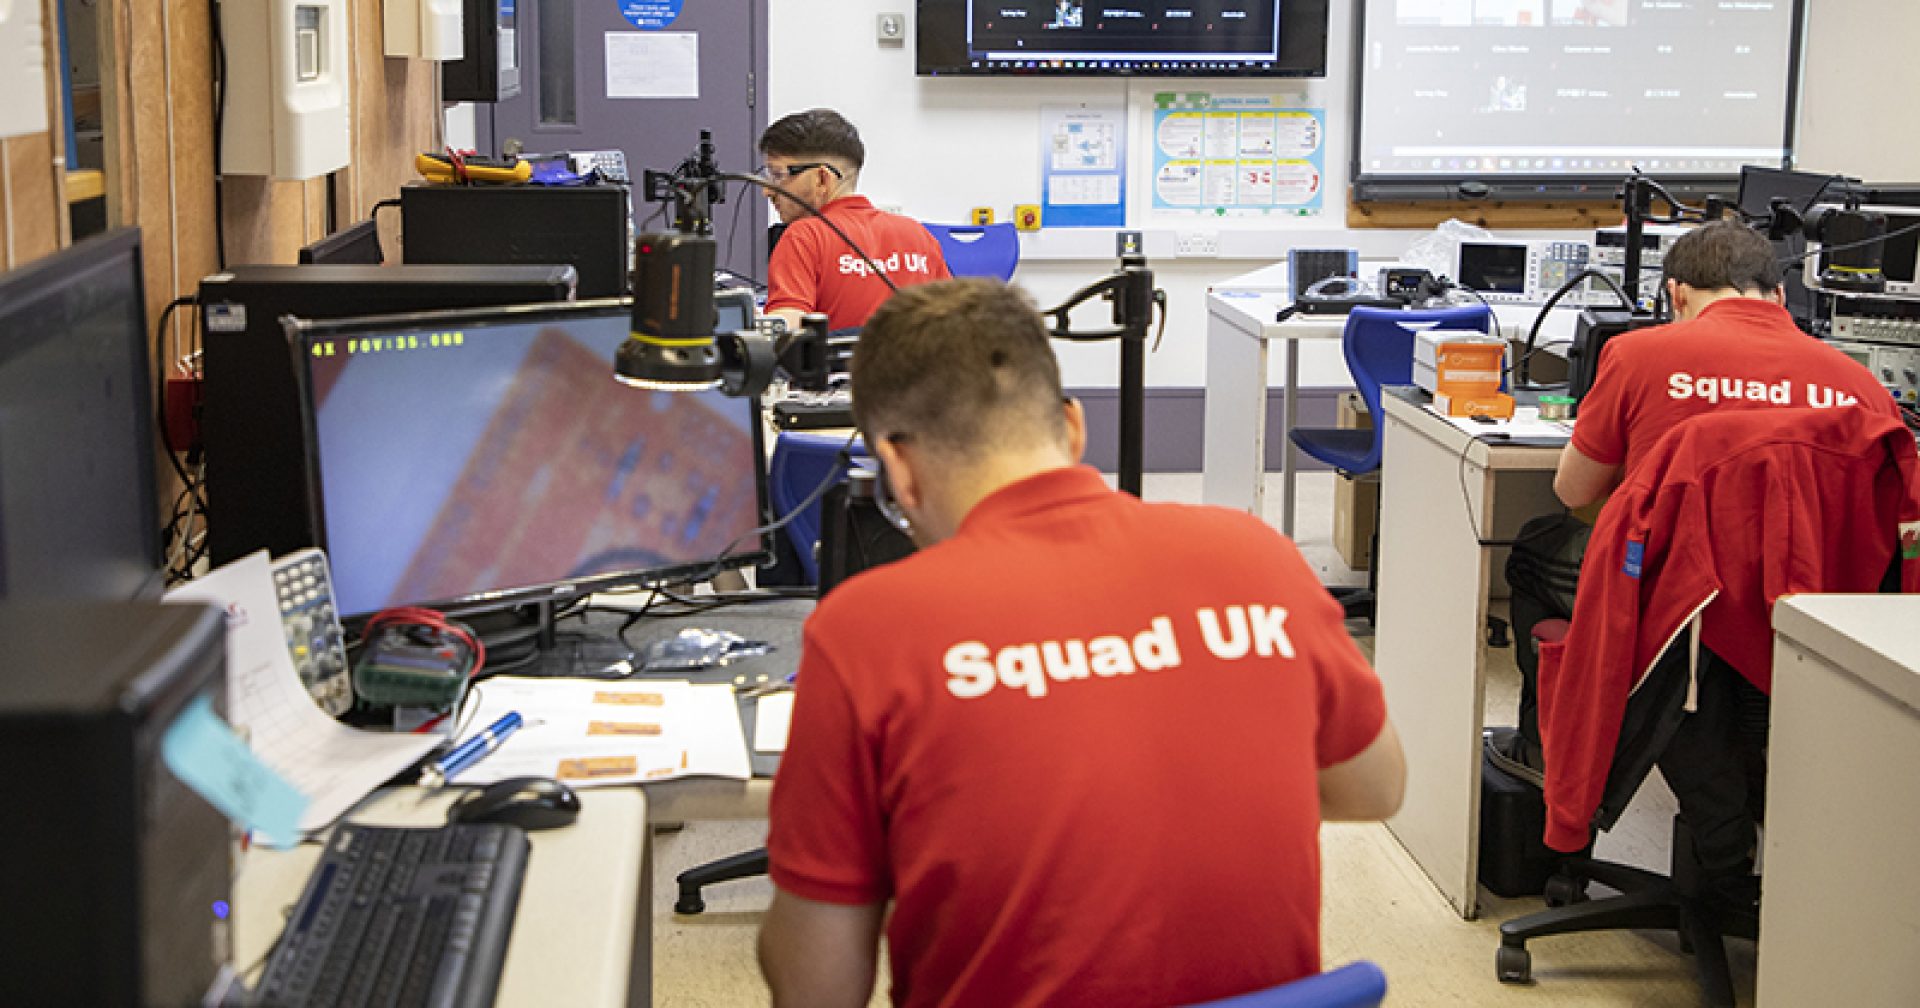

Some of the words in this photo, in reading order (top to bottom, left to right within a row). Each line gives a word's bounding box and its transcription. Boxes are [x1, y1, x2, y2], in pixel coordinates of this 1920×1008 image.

[1667, 373, 1792, 404] Squad
[943, 616, 1182, 698] Squad
[1196, 603, 1296, 660] UK
